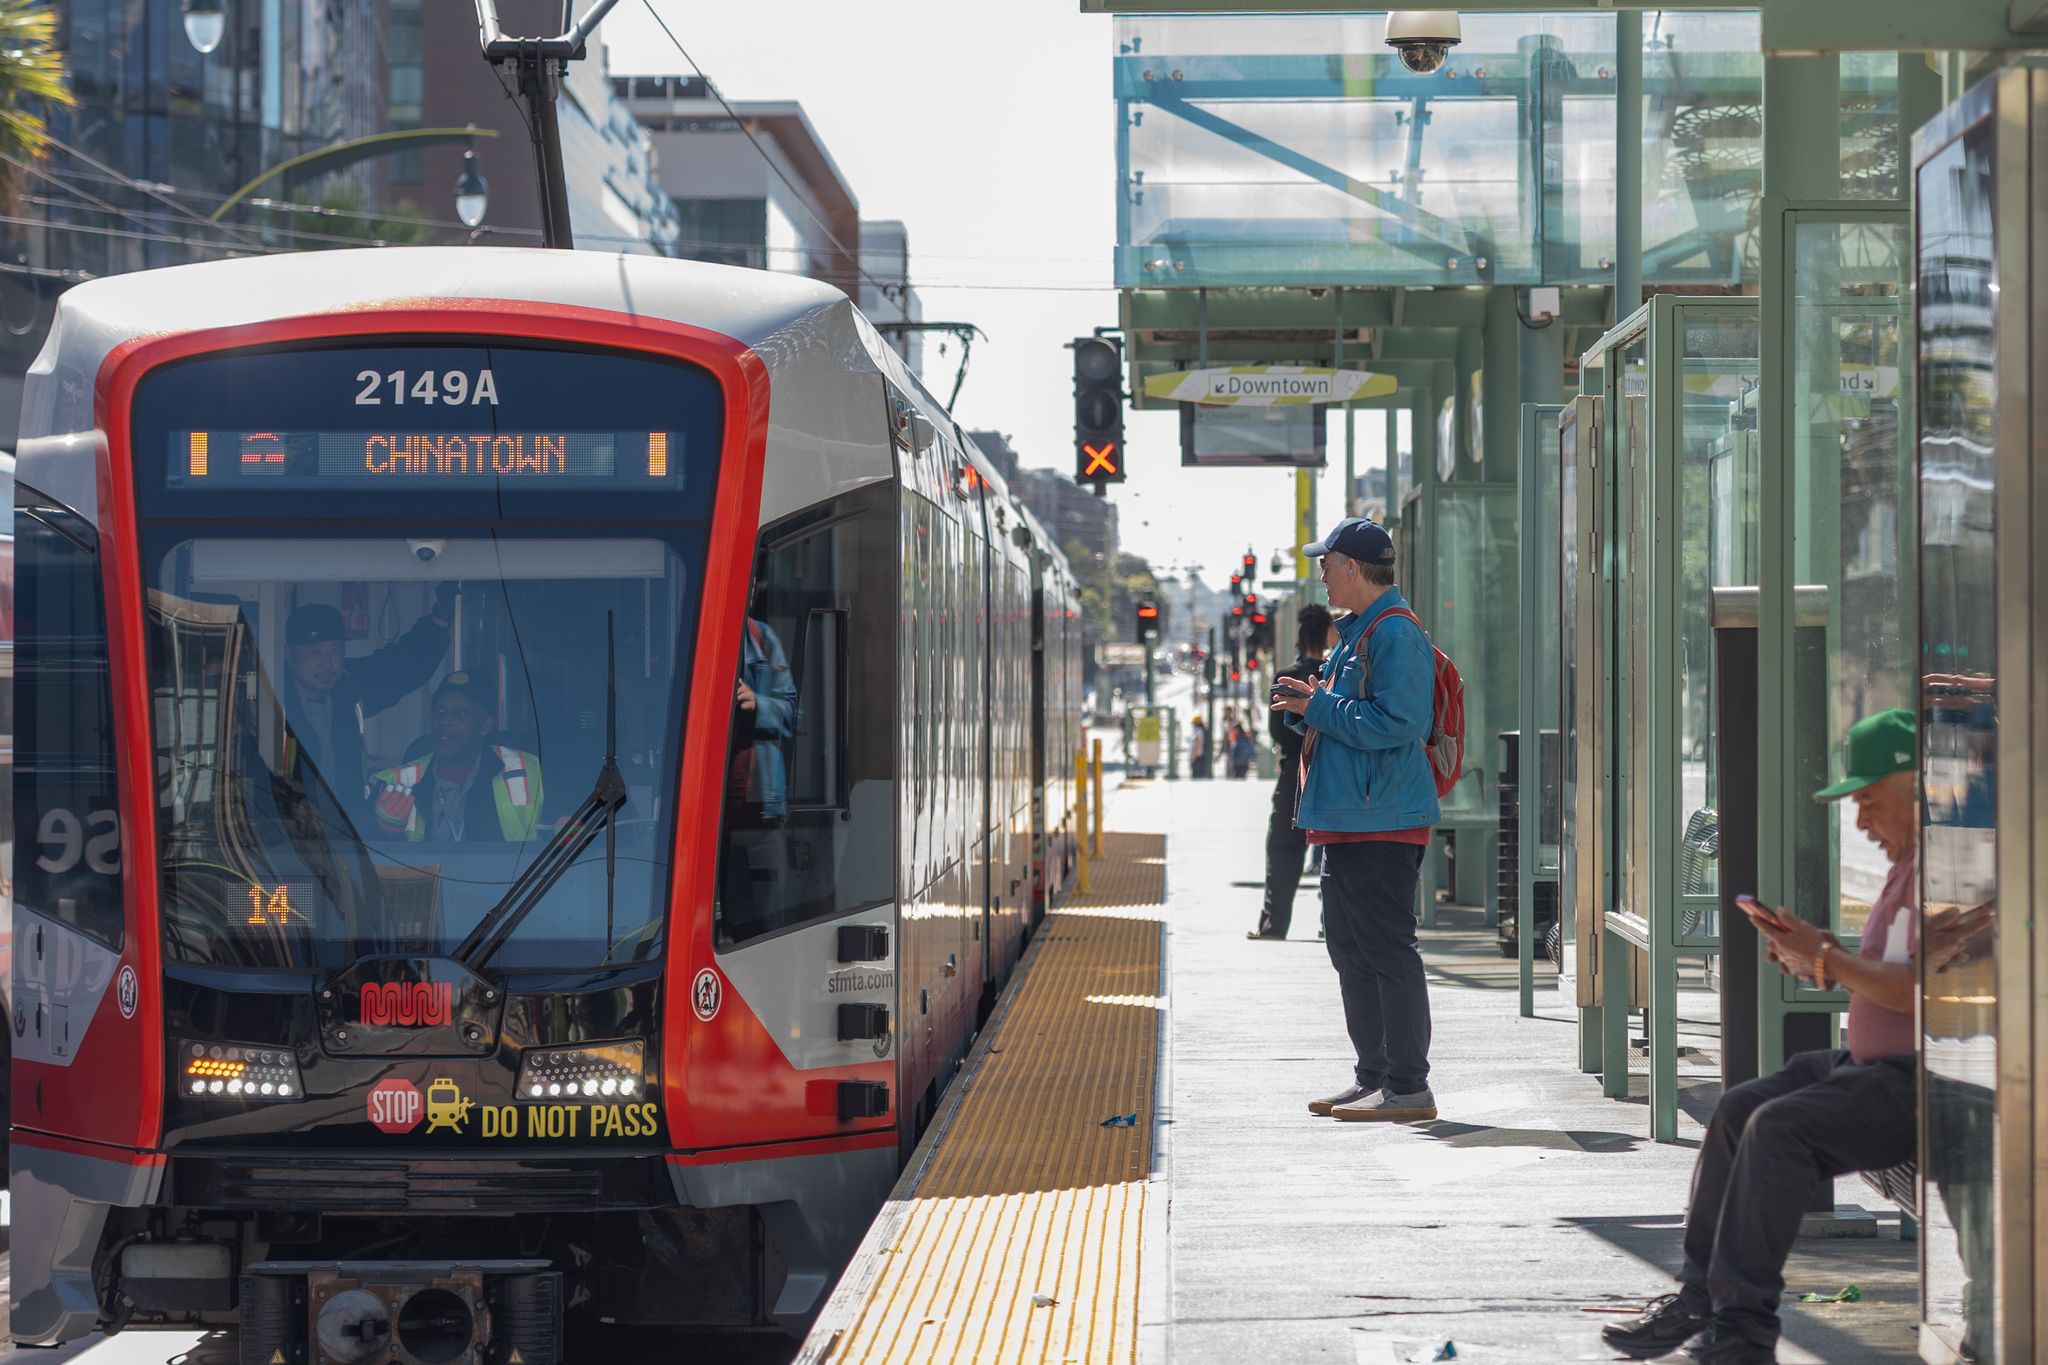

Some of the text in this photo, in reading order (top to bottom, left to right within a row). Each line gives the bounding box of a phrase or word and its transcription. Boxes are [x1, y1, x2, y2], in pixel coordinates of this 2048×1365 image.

[354, 369, 500, 406] 2149A
[1228, 376, 1329, 394] Downtown
[364, 434, 566, 475] CHINATOWN
[247, 884, 290, 924] 14
[828, 971, 894, 994] sfmta.com
[372, 1090, 420, 1124] STOP
[481, 1102, 658, 1138] DO NOT PASS
